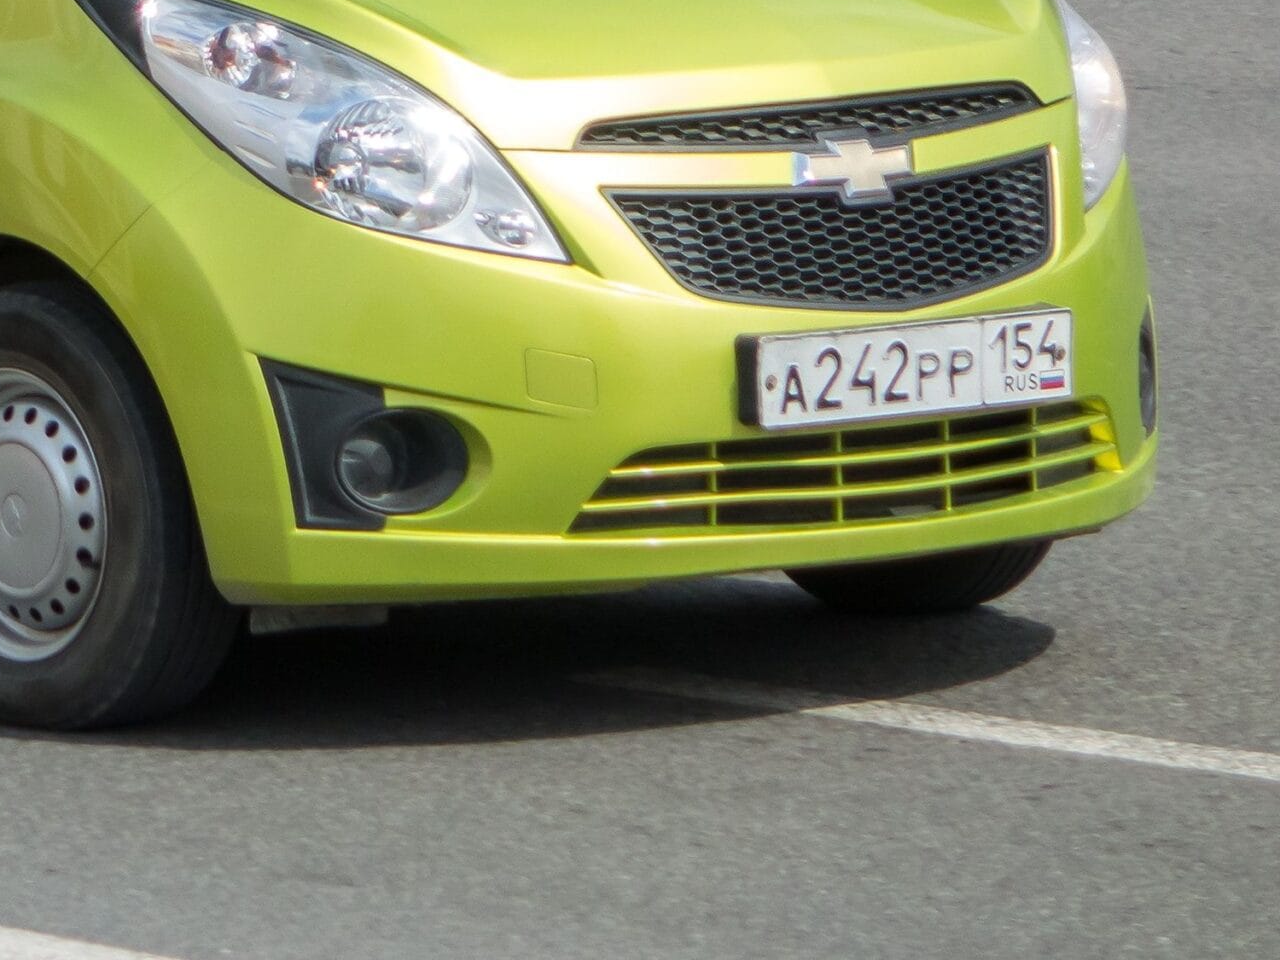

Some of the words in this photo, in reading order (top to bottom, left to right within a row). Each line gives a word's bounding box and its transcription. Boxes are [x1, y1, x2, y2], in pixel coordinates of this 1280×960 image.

[781, 340, 972, 414] A242PP
[990, 320, 1057, 372] 154
[1004, 373, 1038, 392] RUS
